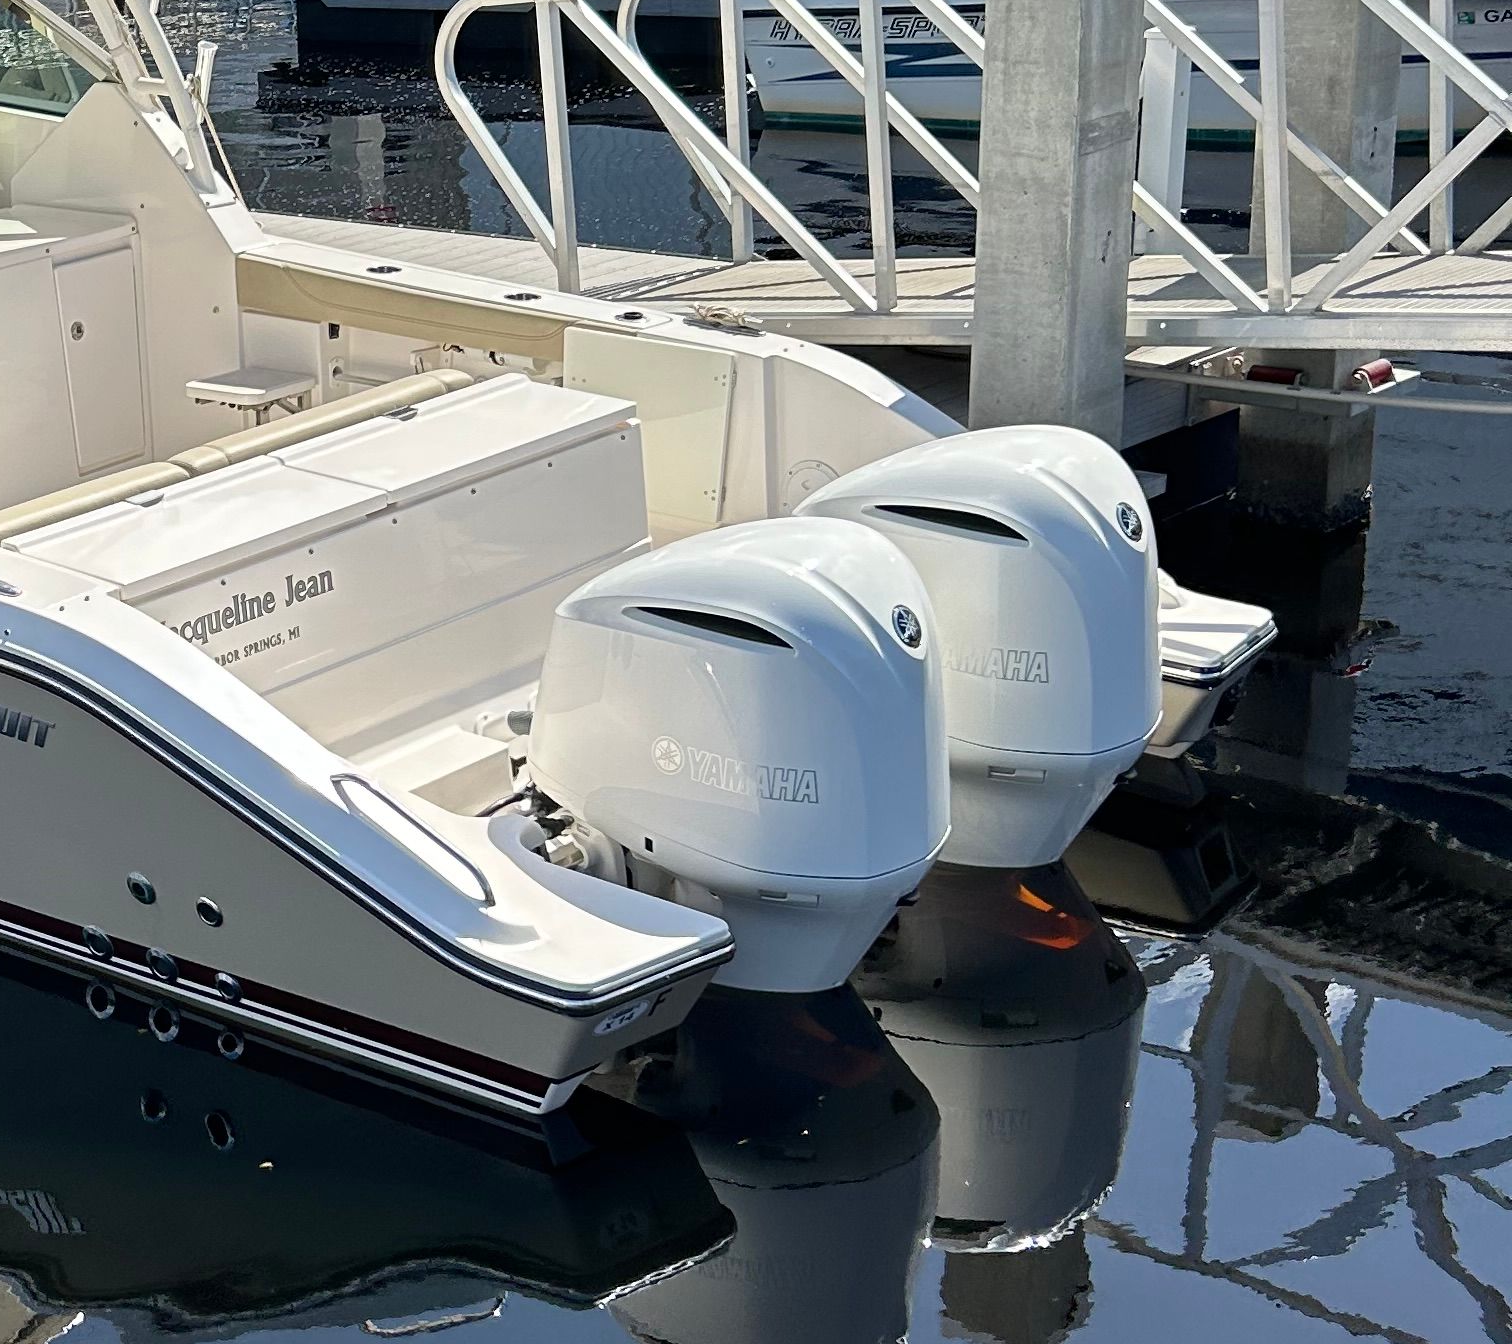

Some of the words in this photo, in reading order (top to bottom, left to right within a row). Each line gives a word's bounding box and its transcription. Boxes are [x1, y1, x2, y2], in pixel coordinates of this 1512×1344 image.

[285, 570, 334, 607] Jean
[243, 632, 286, 658] SPRINGS,
[289, 625, 301, 641] MI
[687, 746, 819, 804] YAMAHA
